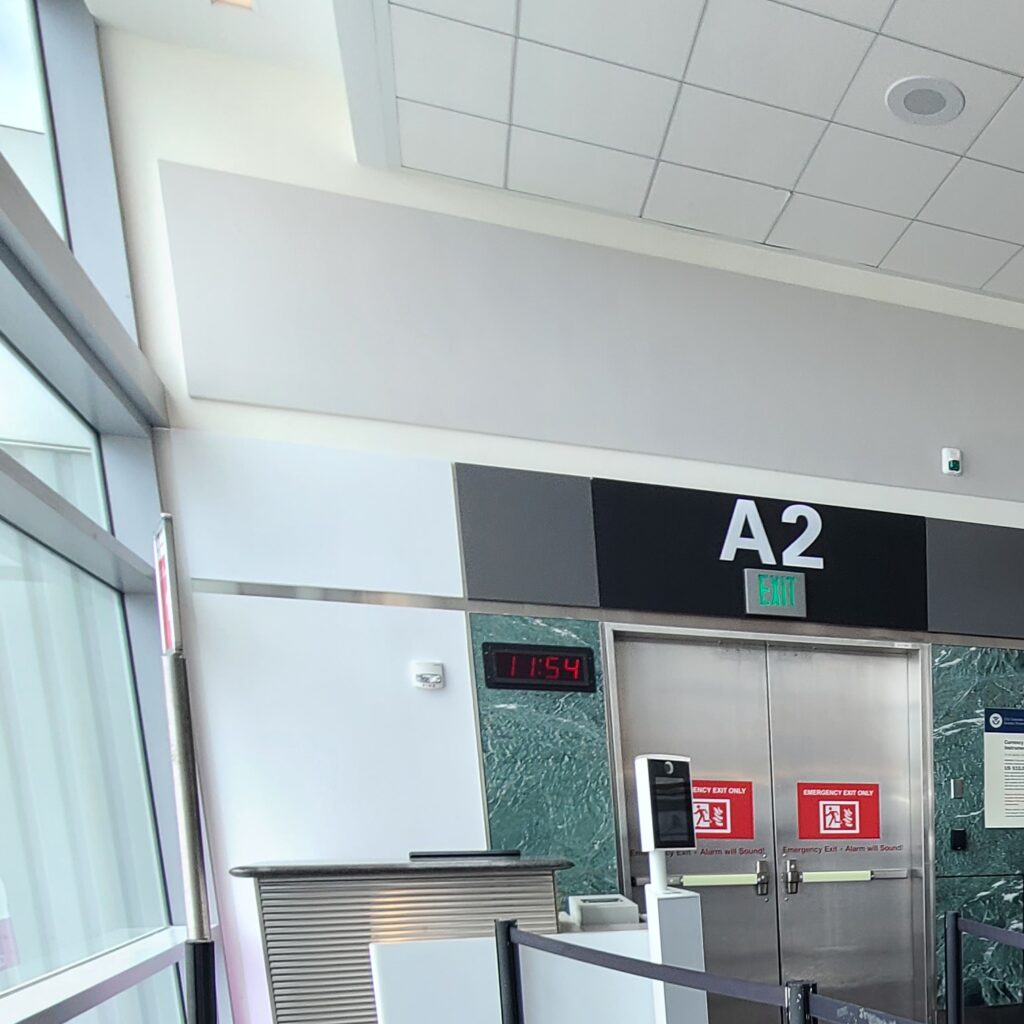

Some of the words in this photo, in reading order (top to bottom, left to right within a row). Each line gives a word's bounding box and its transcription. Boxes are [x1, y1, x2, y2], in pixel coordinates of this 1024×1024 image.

[719, 498, 825, 570] A2
[758, 574, 796, 608] EXIT
[509, 655, 581, 681] 11:54
[700, 848, 723, 856] Alarm
[782, 846, 822, 854] Emergency
[845, 844, 866, 852] Alarm
